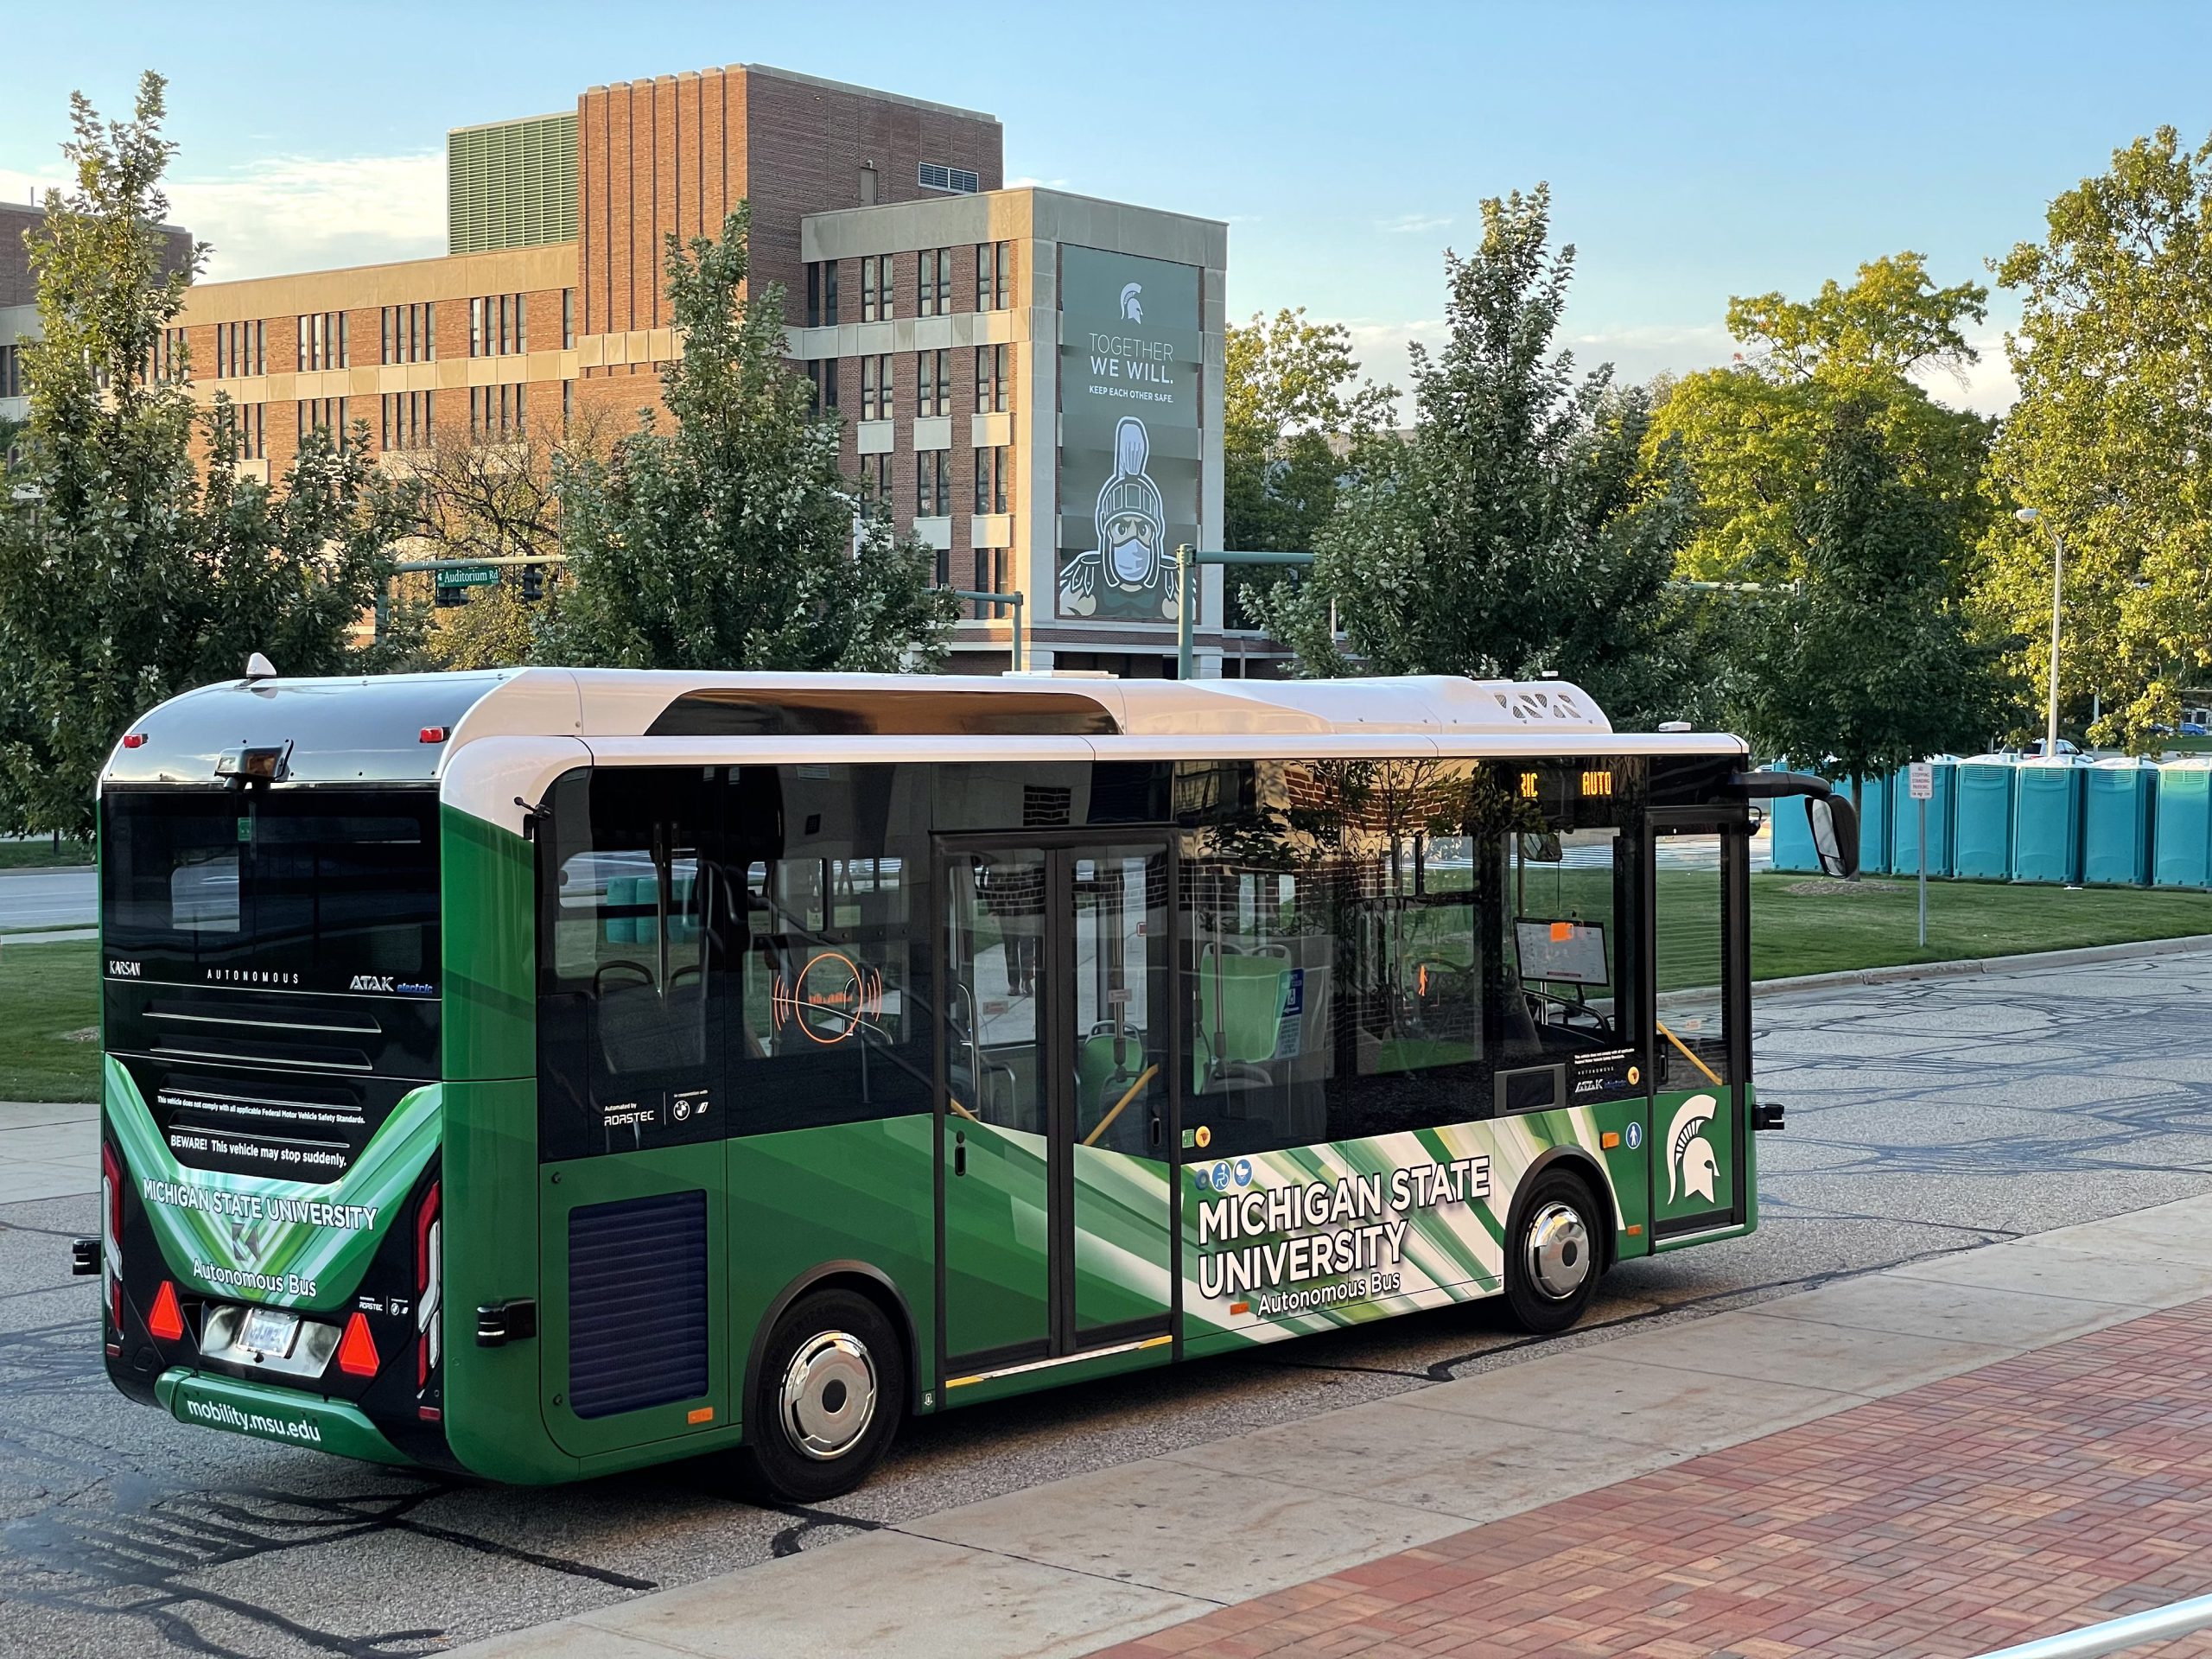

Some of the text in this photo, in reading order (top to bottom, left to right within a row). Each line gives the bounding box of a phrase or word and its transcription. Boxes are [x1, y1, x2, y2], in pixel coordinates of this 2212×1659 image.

[1089, 333, 1173, 362] TOGETHER
[1090, 356, 1173, 385] WE WILL.
[1090, 385, 1173, 403] KEEP EACH OTHER SAFE.
[444, 569, 487, 583] Auditorium
[489, 569, 499, 579] Rd
[1582, 772, 1611, 795] AUTO
[109, 961, 141, 976] KARSAN
[207, 969, 299, 984] AUTONOMOUS
[349, 976, 433, 995] ATAK electric
[1575, 1078, 1604, 1093] ATAK
[157, 1096, 167, 1104] This
[167, 1097, 181, 1106] vehicle
[182, 1099, 194, 1108] does
[202, 1102, 219, 1111] comply
[237, 1105, 261, 1116] applicable
[262, 1108, 281, 1118] Federal
[282, 1109, 297, 1119] Motor
[298, 1111, 317, 1121] Vehicle
[318, 1113, 335, 1123] Safety
[336, 1114, 365, 1124] Standards.
[604, 1110, 654, 1126] ADASTEC
[171, 1135, 347, 1168] BEWARE! This vehicle may stop suddenly.
[143, 1178, 378, 1230] MICHIGAN STATE UNIVERSITY
[1198, 1154, 1491, 1246] MICHIGAN STATE
[1198, 1219, 1408, 1300] UNIVERSITY
[193, 1258, 317, 1298] Autonomous Bus
[1256, 1271, 1401, 1319] Autonomous Bus
[187, 1397, 321, 1443] mobility.msu.edu
